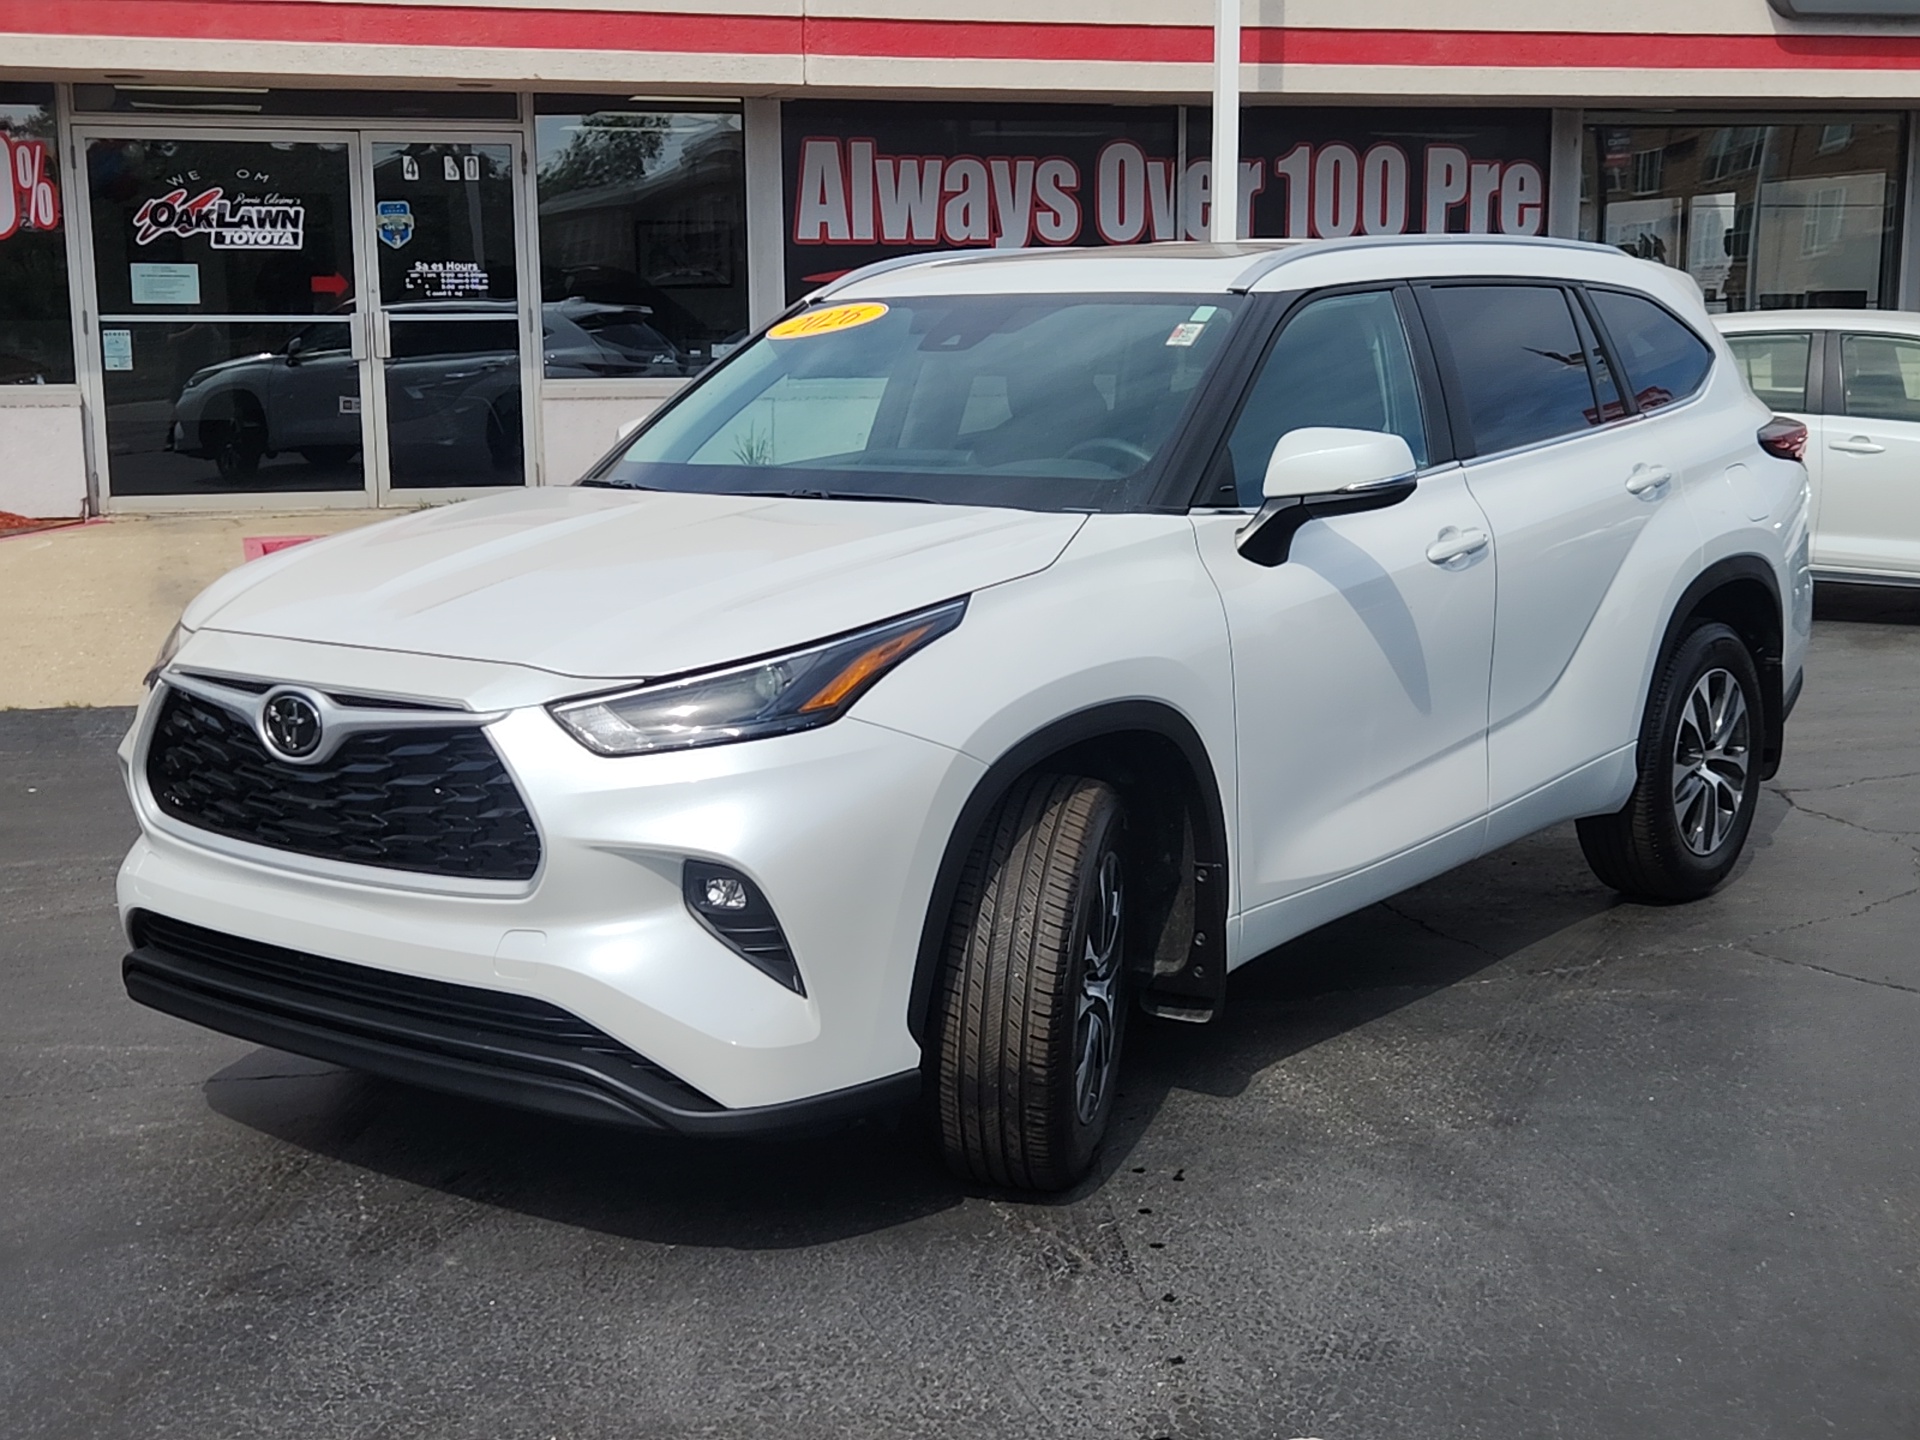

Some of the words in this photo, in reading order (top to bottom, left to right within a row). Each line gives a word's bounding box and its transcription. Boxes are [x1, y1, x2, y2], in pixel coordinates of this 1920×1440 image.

[797, 140, 1079, 248] Always
[1099, 142, 1263, 242] Over
[1277, 144, 1407, 239] 100
[1426, 147, 1543, 235] Pre
[221, 231, 295, 245] TOYOTA
[446, 261, 478, 271] Hours
